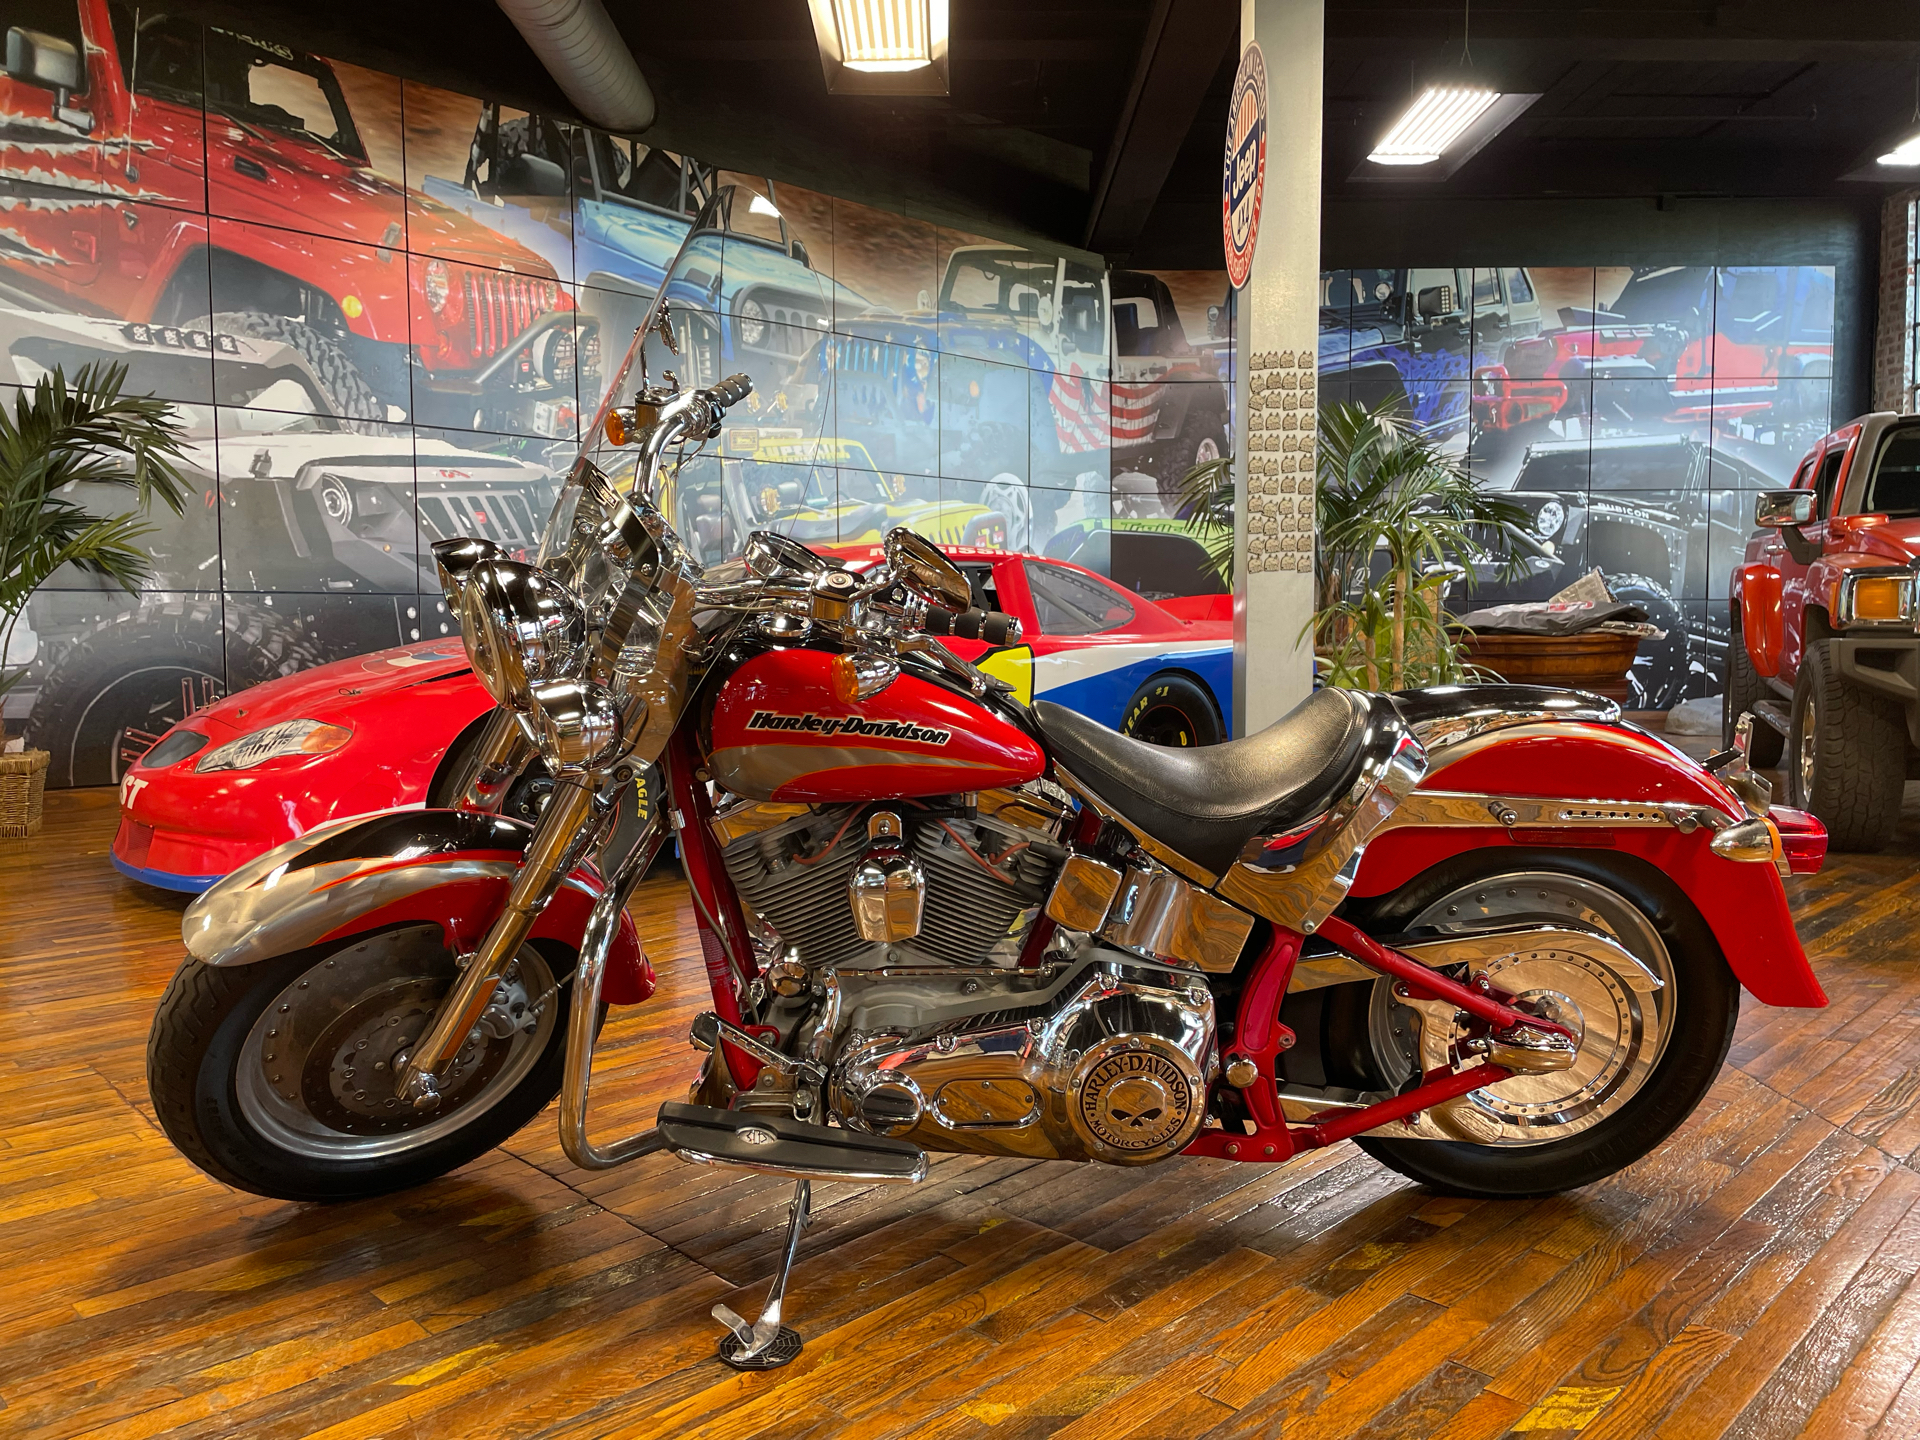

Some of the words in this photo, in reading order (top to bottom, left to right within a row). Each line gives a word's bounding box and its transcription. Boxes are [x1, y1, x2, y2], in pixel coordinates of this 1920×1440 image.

[1225, 138, 1233, 178] THE
[1229, 53, 1254, 135] AMERICAN
[1252, 54, 1266, 120] LEGEND
[1232, 139, 1257, 199] Jeep
[1225, 210, 1245, 280] ESTABLISHED
[1244, 214, 1258, 270] SINCE
[1255, 157, 1265, 211] 1941
[1597, 502, 1650, 520] RUBICON
[747, 710, 951, 745] Harley-Davidson
[634, 774, 649, 820] AGLE
[1085, 1055, 1188, 1112] HARLEY-DAVIDSON
[1089, 1117, 1182, 1148] MOTORCYCLES
